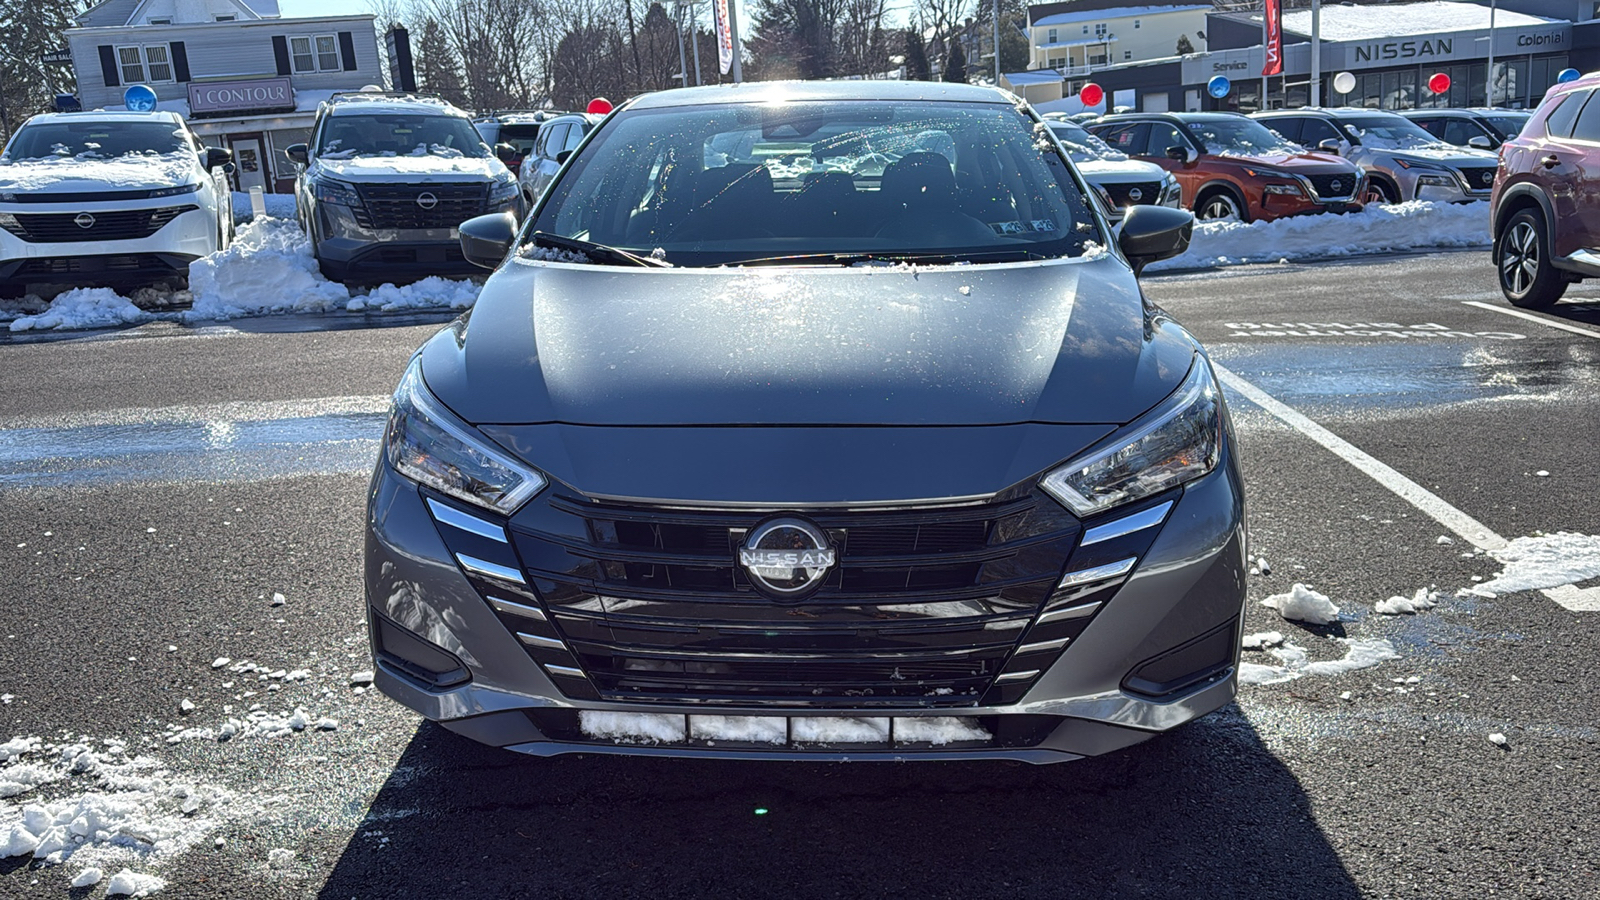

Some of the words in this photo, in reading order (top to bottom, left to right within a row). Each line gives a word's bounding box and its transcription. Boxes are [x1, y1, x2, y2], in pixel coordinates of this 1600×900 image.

[1517, 31, 1564, 46] Colonial
[1355, 38, 1452, 62] NISSAN
[1213, 60, 1248, 72] Service
[206, 86, 285, 104] CONTOUR
[1224, 322, 1450, 330] Parking
[1228, 330, 1526, 340] Customer
[742, 551, 832, 565] NISSAN
